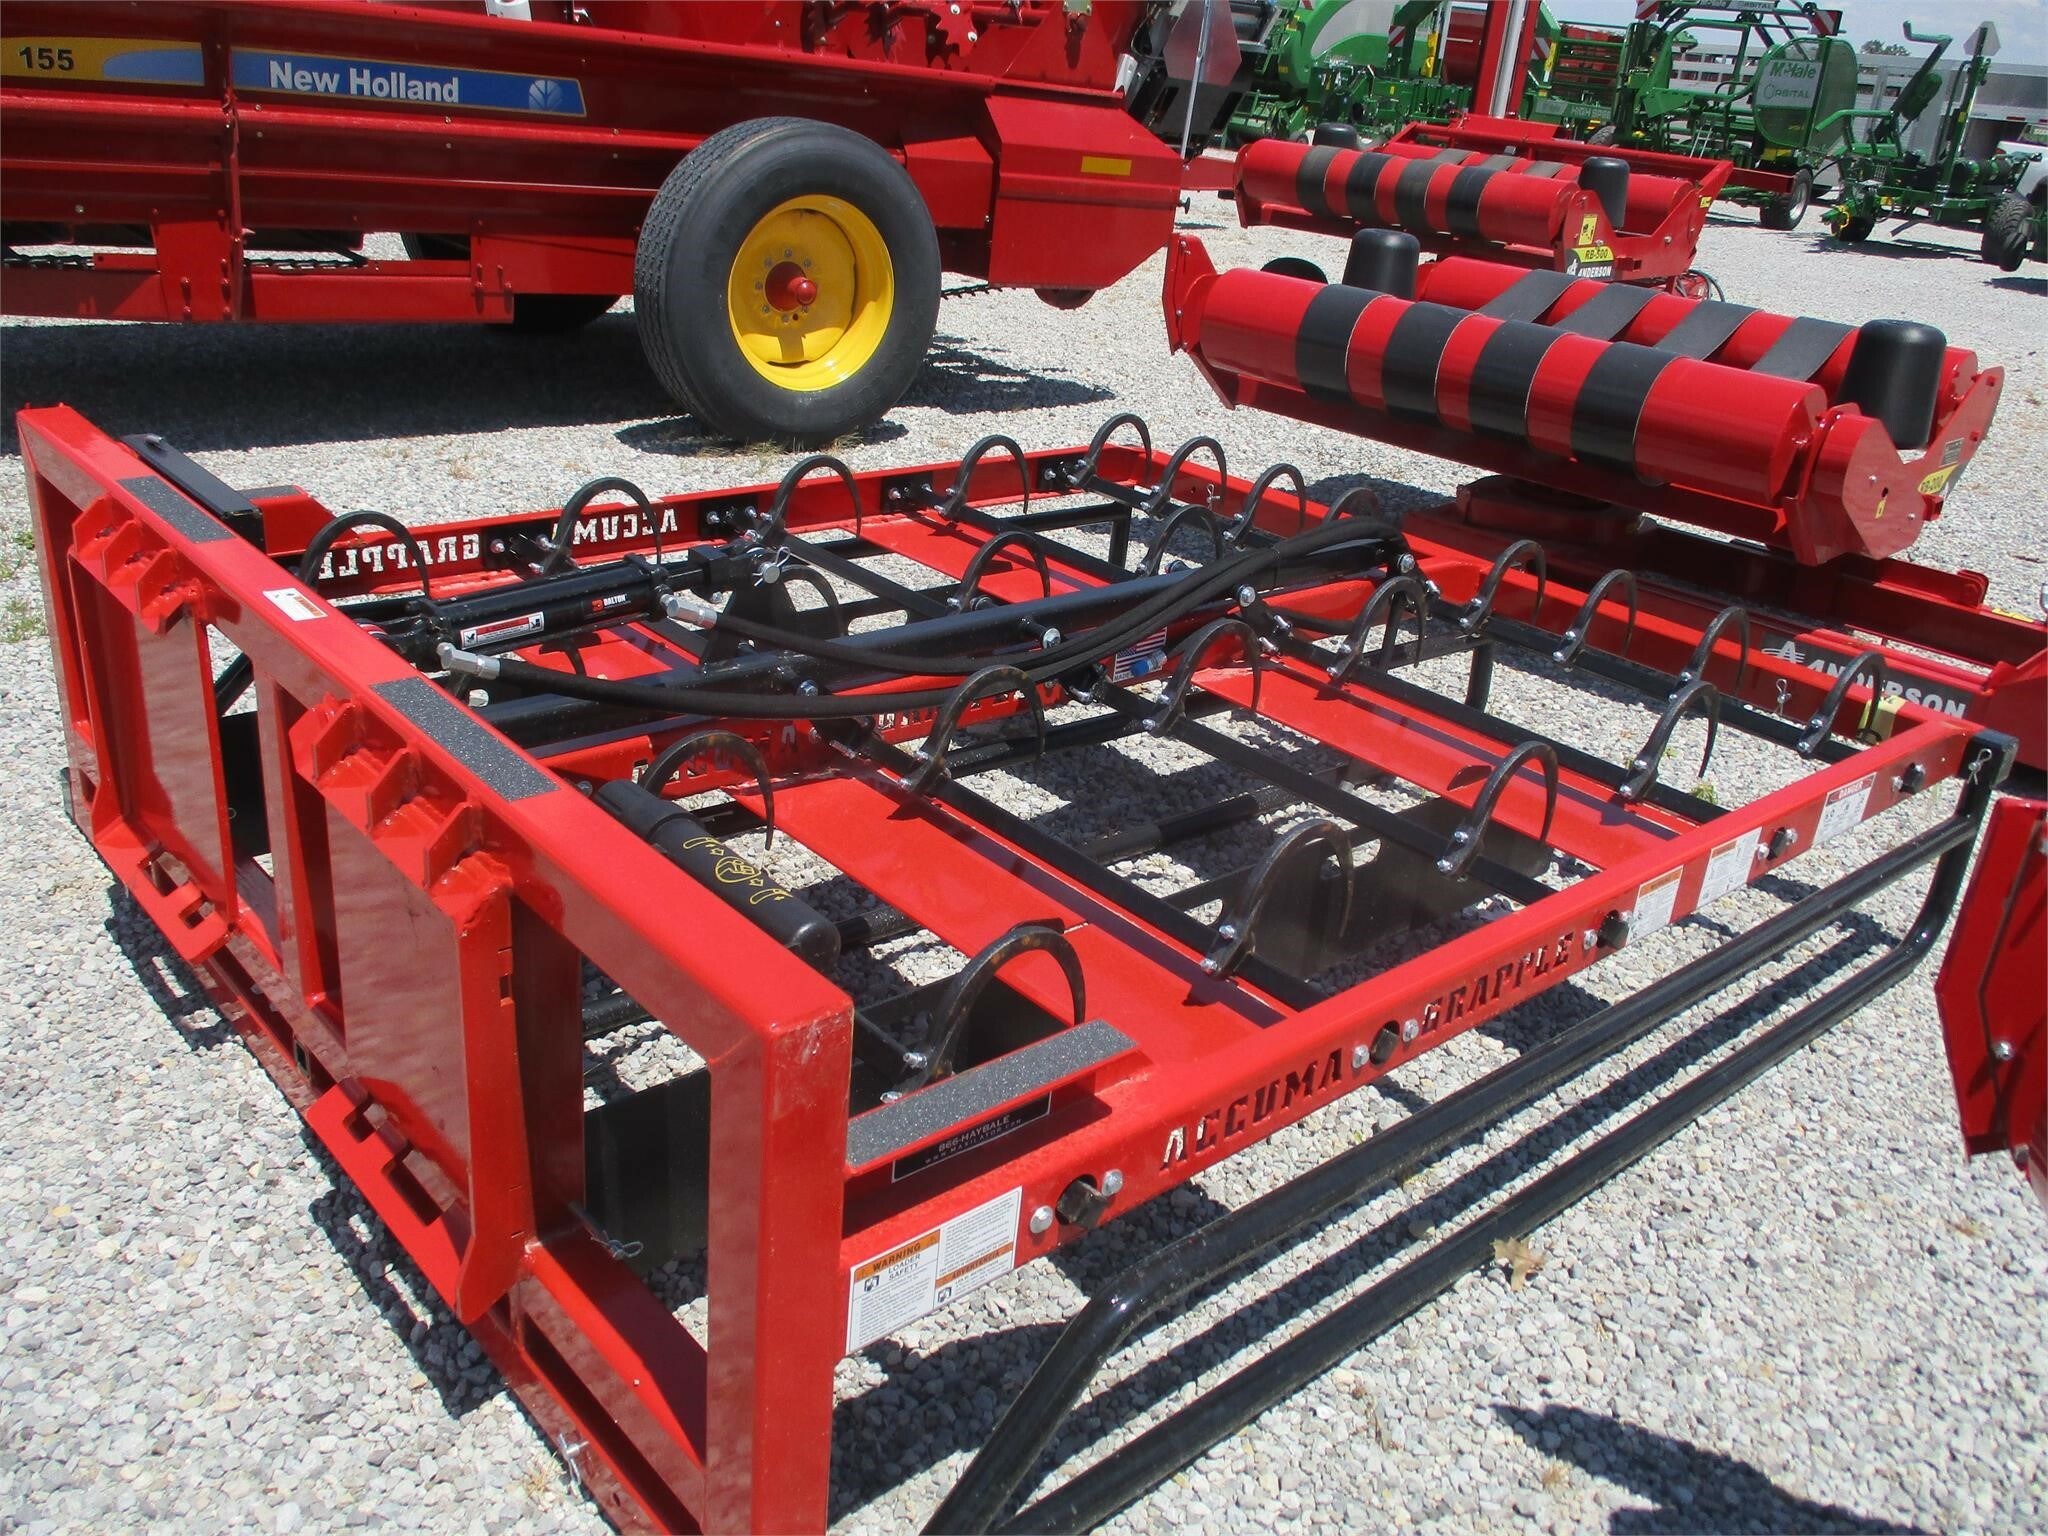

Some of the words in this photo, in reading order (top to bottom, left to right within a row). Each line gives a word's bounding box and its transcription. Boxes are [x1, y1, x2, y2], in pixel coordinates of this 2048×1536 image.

[19, 46, 75, 71] 155
[269, 60, 340, 94] New
[349, 68, 459, 103] Holland
[1763, 83, 1810, 100] ORBITAL
[1585, 250, 1608, 260] RB-500
[1578, 266, 1612, 278] ANDERSON
[603, 594, 626, 606] DALTON
[1420, 931, 1574, 1036] GRAPPLE
[1160, 1047, 1343, 1176] ACCUMA
[938, 1114, 1011, 1152] 866-HAYBALE
[872, 1242, 921, 1272] WARNING
[888, 1253, 921, 1274] LOADER
[888, 1262, 919, 1281] SAFETY
